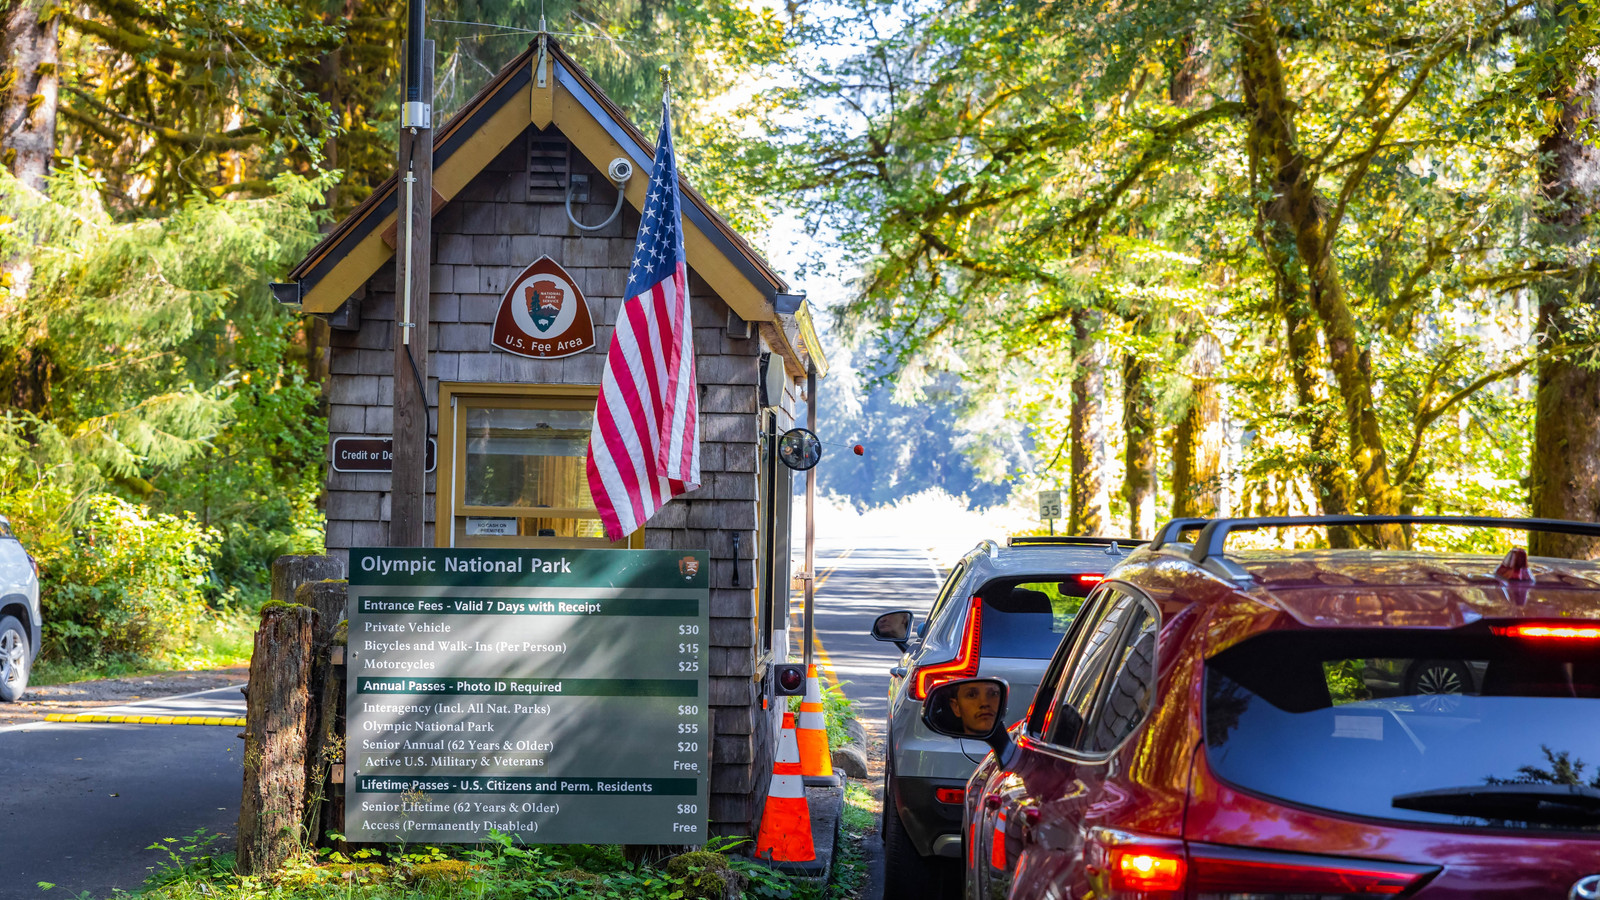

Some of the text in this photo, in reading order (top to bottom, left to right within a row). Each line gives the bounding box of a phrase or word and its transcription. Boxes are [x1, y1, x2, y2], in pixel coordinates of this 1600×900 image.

[506, 335, 583, 352] U.S. Fee Area
[342, 450, 367, 460] Credit
[1042, 505, 1059, 516] 35
[361, 556, 571, 574] Olympic National Park
[364, 600, 414, 611] Entrance
[418, 601, 443, 611] Fees
[455, 601, 483, 611] Valid
[487, 601, 493, 611] 7
[497, 601, 525, 614] Days
[529, 601, 554, 612] with
[558, 602, 601, 615] Receipt
[364, 622, 699, 636] Private Vehicle $30
[364, 640, 411, 653] Bicycles
[414, 641, 433, 651] and
[475, 642, 493, 651] Ins
[496, 642, 520, 653] (Per
[522, 642, 567, 654] Person)
[679, 643, 699, 654] $15
[364, 658, 699, 672] Motorcycles $25
[363, 681, 405, 691] Annual
[409, 681, 445, 691] Passes
[457, 682, 491, 692] Photo
[494, 682, 506, 692] ID
[510, 682, 562, 694] Required
[363, 703, 698, 716] Interagency (Incl. All Nat. Parks) $80
[363, 721, 698, 734] Olympic National Park $55
[363, 739, 698, 753] Senior Annual (62 Years & Older) $20
[365, 756, 697, 771] Active U.S. Military & Veterans Free
[361, 780, 409, 790] Lifetime
[412, 780, 449, 791] Passes
[460, 781, 483, 791] U.S.
[486, 780, 531, 791] Citizens
[535, 781, 557, 791] and
[560, 781, 593, 791] Perm.
[597, 781, 653, 792] Residents
[362, 802, 697, 815] Senior Lifetime (62 Years & Older) $80
[362, 820, 697, 833] Access (Permanently Disabled) Free
